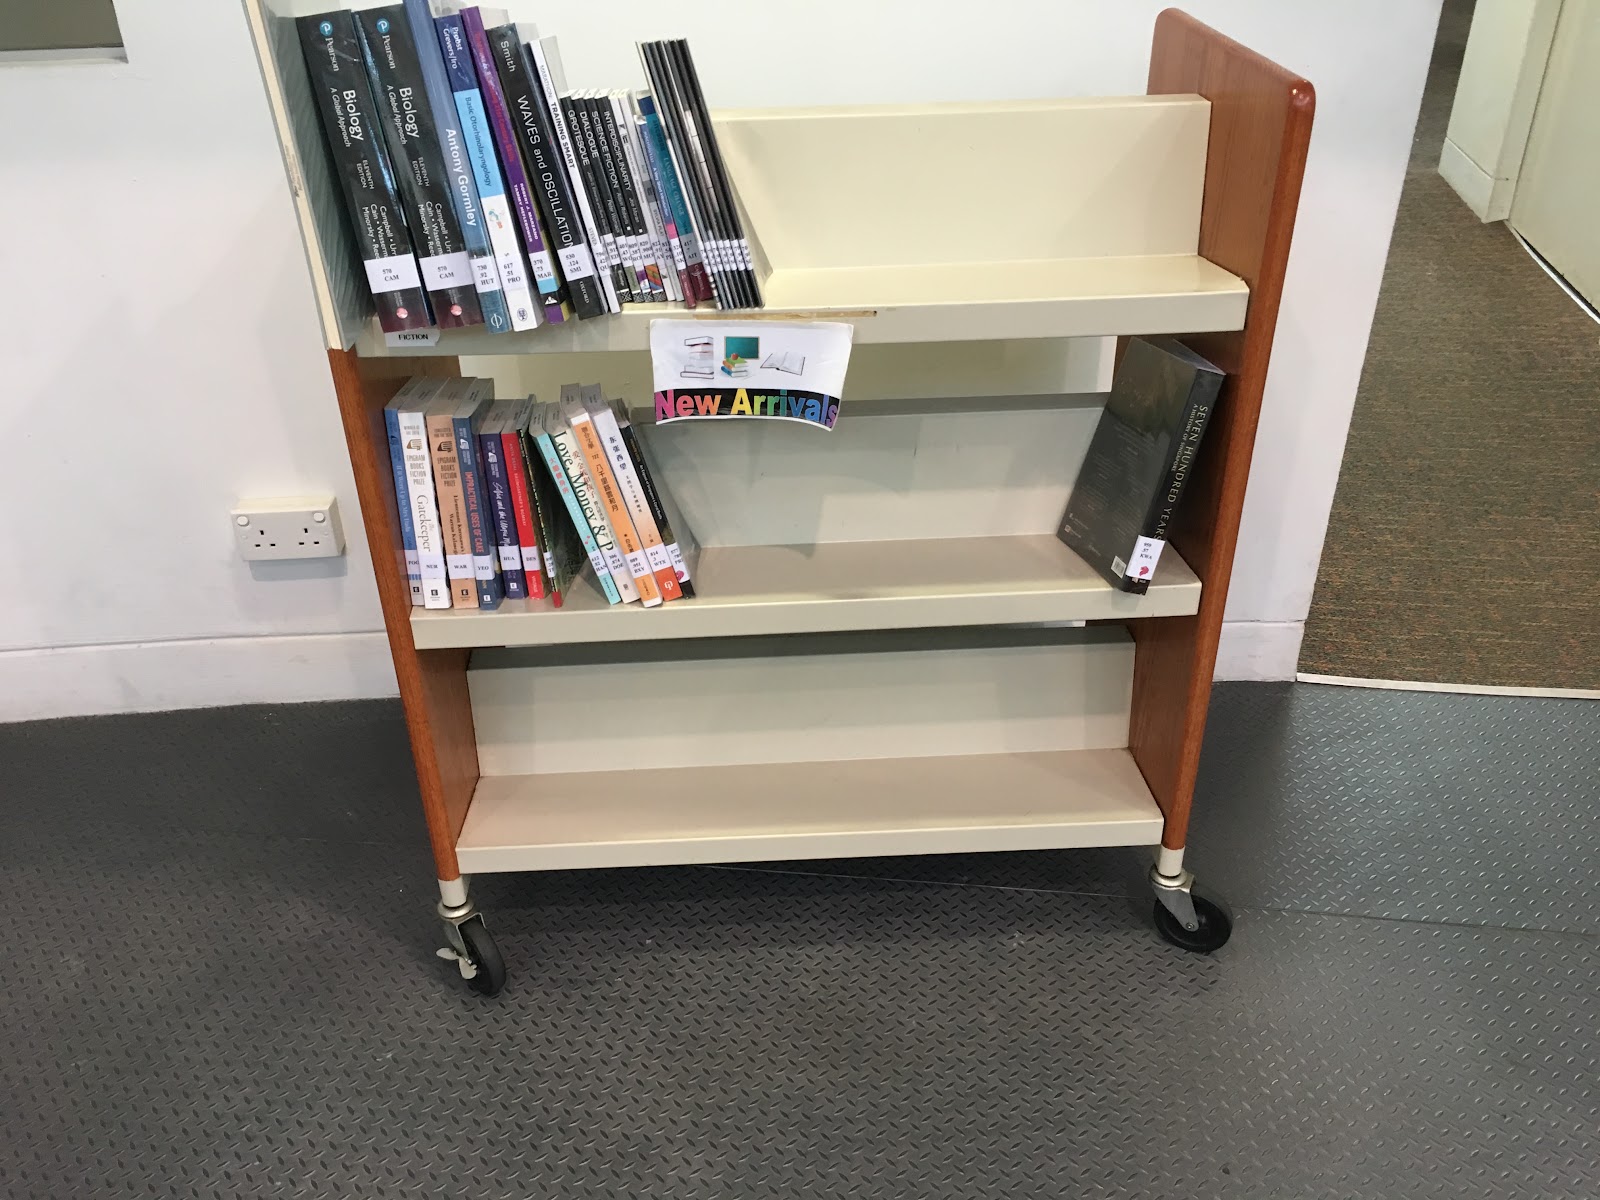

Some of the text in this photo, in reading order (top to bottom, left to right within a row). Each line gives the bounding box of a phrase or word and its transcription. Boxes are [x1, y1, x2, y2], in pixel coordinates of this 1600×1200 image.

[326, 37, 338, 71] Pearson
[382, 34, 395, 69] Pearson
[442, 28, 457, 69] Grevers/Iro
[452, 26, 462, 50] Probst
[500, 40, 515, 72] Smith
[332, 94, 342, 115] Global
[337, 115, 351, 147] Approach
[343, 89, 363, 141] Biology
[388, 91, 398, 113] Global
[393, 112, 407, 144] Approach
[399, 86, 420, 138] Biology
[465, 96, 492, 187] Basic Otorhinolaryngology
[517, 94, 540, 144] WAVES
[533, 147, 546, 169] and
[551, 102, 566, 140] TRAINING
[562, 141, 574, 168] SMART
[567, 109, 589, 165] GROTESQUE
[580, 111, 598, 158] DIALOGUE
[505, 143, 514, 161] Skills
[591, 110, 618, 188] SCIENCE FICTION
[603, 110, 630, 191] INTERDISCIPLINARITY
[356, 163, 366, 187] EDITION
[362, 159, 373, 189] ELEVENTH
[412, 160, 422, 185] EDITION
[418, 156, 429, 186] ELEVENTH
[444, 127, 477, 226] Antony Gormley
[370, 203, 379, 219] Cain
[425, 200, 434, 216] Cain
[434, 202, 447, 234] Campbell
[514, 184, 532, 242] TAMMY HEFLEBOWER
[519, 182, 528, 204] ROBERT
[527, 211, 538, 239] MARZANO
[620, 206, 629, 224] Roberts
[660, 192, 668, 216] Introduction
[672, 190, 684, 215] CHANGE
[362, 206, 374, 237] Minorsky
[379, 205, 392, 237] Campbell
[417, 204, 429, 235] Minorsky
[611, 213, 619, 232] Womack
[579, 280, 589, 303] OXFORD
[655, 388, 839, 428] New Arrivals
[1185, 409, 1197, 433] HISTORY
[1188, 405, 1208, 441] SEVEN
[609, 436, 627, 470] 东张西望
[1171, 441, 1185, 472] SINGAPORE
[465, 471, 476, 510] IMPRACTICAL
[1168, 446, 1194, 502] HUNDRED
[399, 491, 405, 499] Up
[571, 475, 597, 521] Money
[592, 524, 606, 539] &
[415, 494, 432, 552] Gatekeeper
[471, 512, 479, 527] USES
[498, 510, 506, 518] the
[474, 537, 483, 552] CAKE
